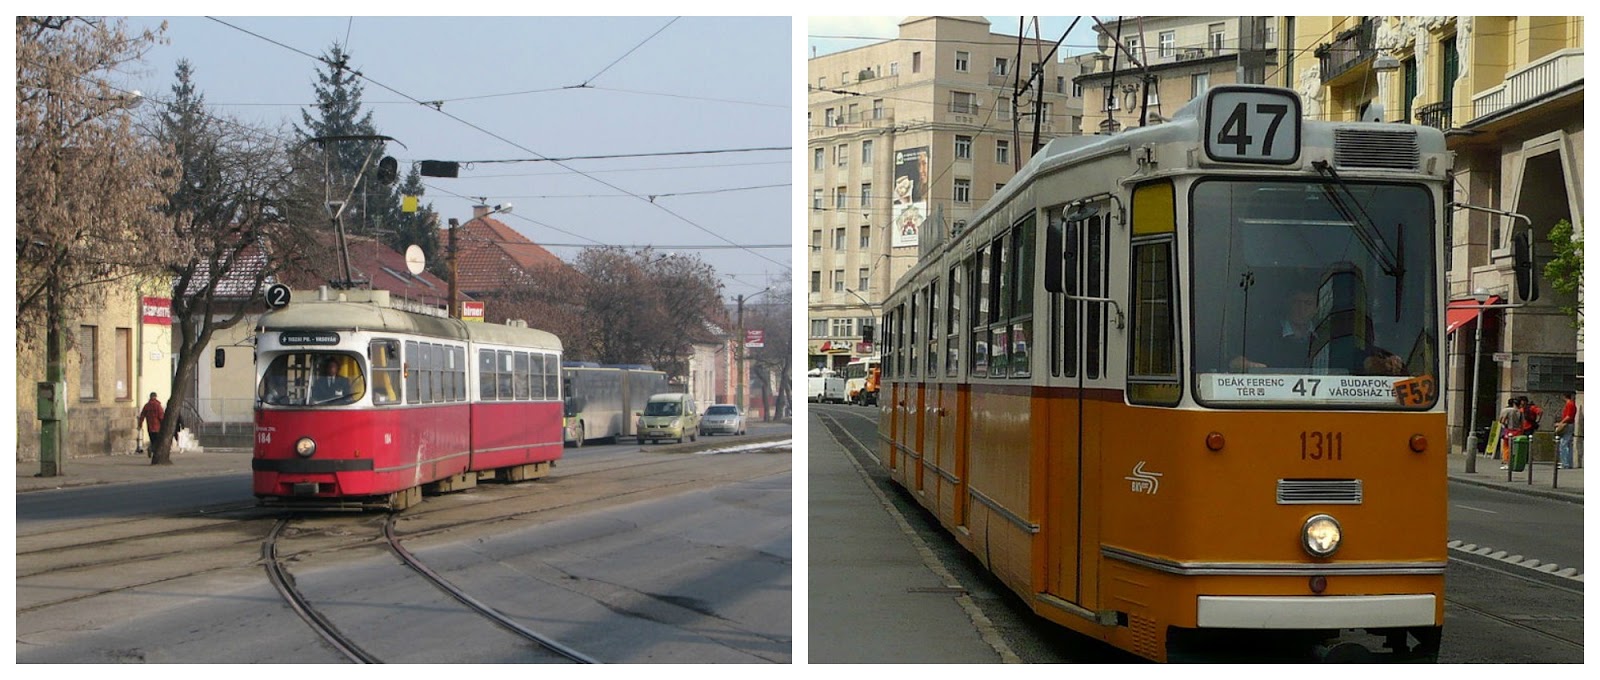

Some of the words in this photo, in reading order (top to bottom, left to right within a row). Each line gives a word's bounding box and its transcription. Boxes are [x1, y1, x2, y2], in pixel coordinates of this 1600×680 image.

[1217, 102, 1288, 156] 47
[273, 287, 286, 305] 2
[1217, 376, 1245, 386] DEÁK
[1246, 378, 1285, 386] FERENC
[1292, 378, 1321, 396] 47
[1236, 386, 1256, 396] TÉR
[1328, 387, 1382, 397] VÁROSHÁZ
[1385, 388, 1397, 397] TÉ
[1395, 379, 1434, 406] F52
[257, 432, 271, 444] 184
[1300, 431, 1342, 460] 1311
